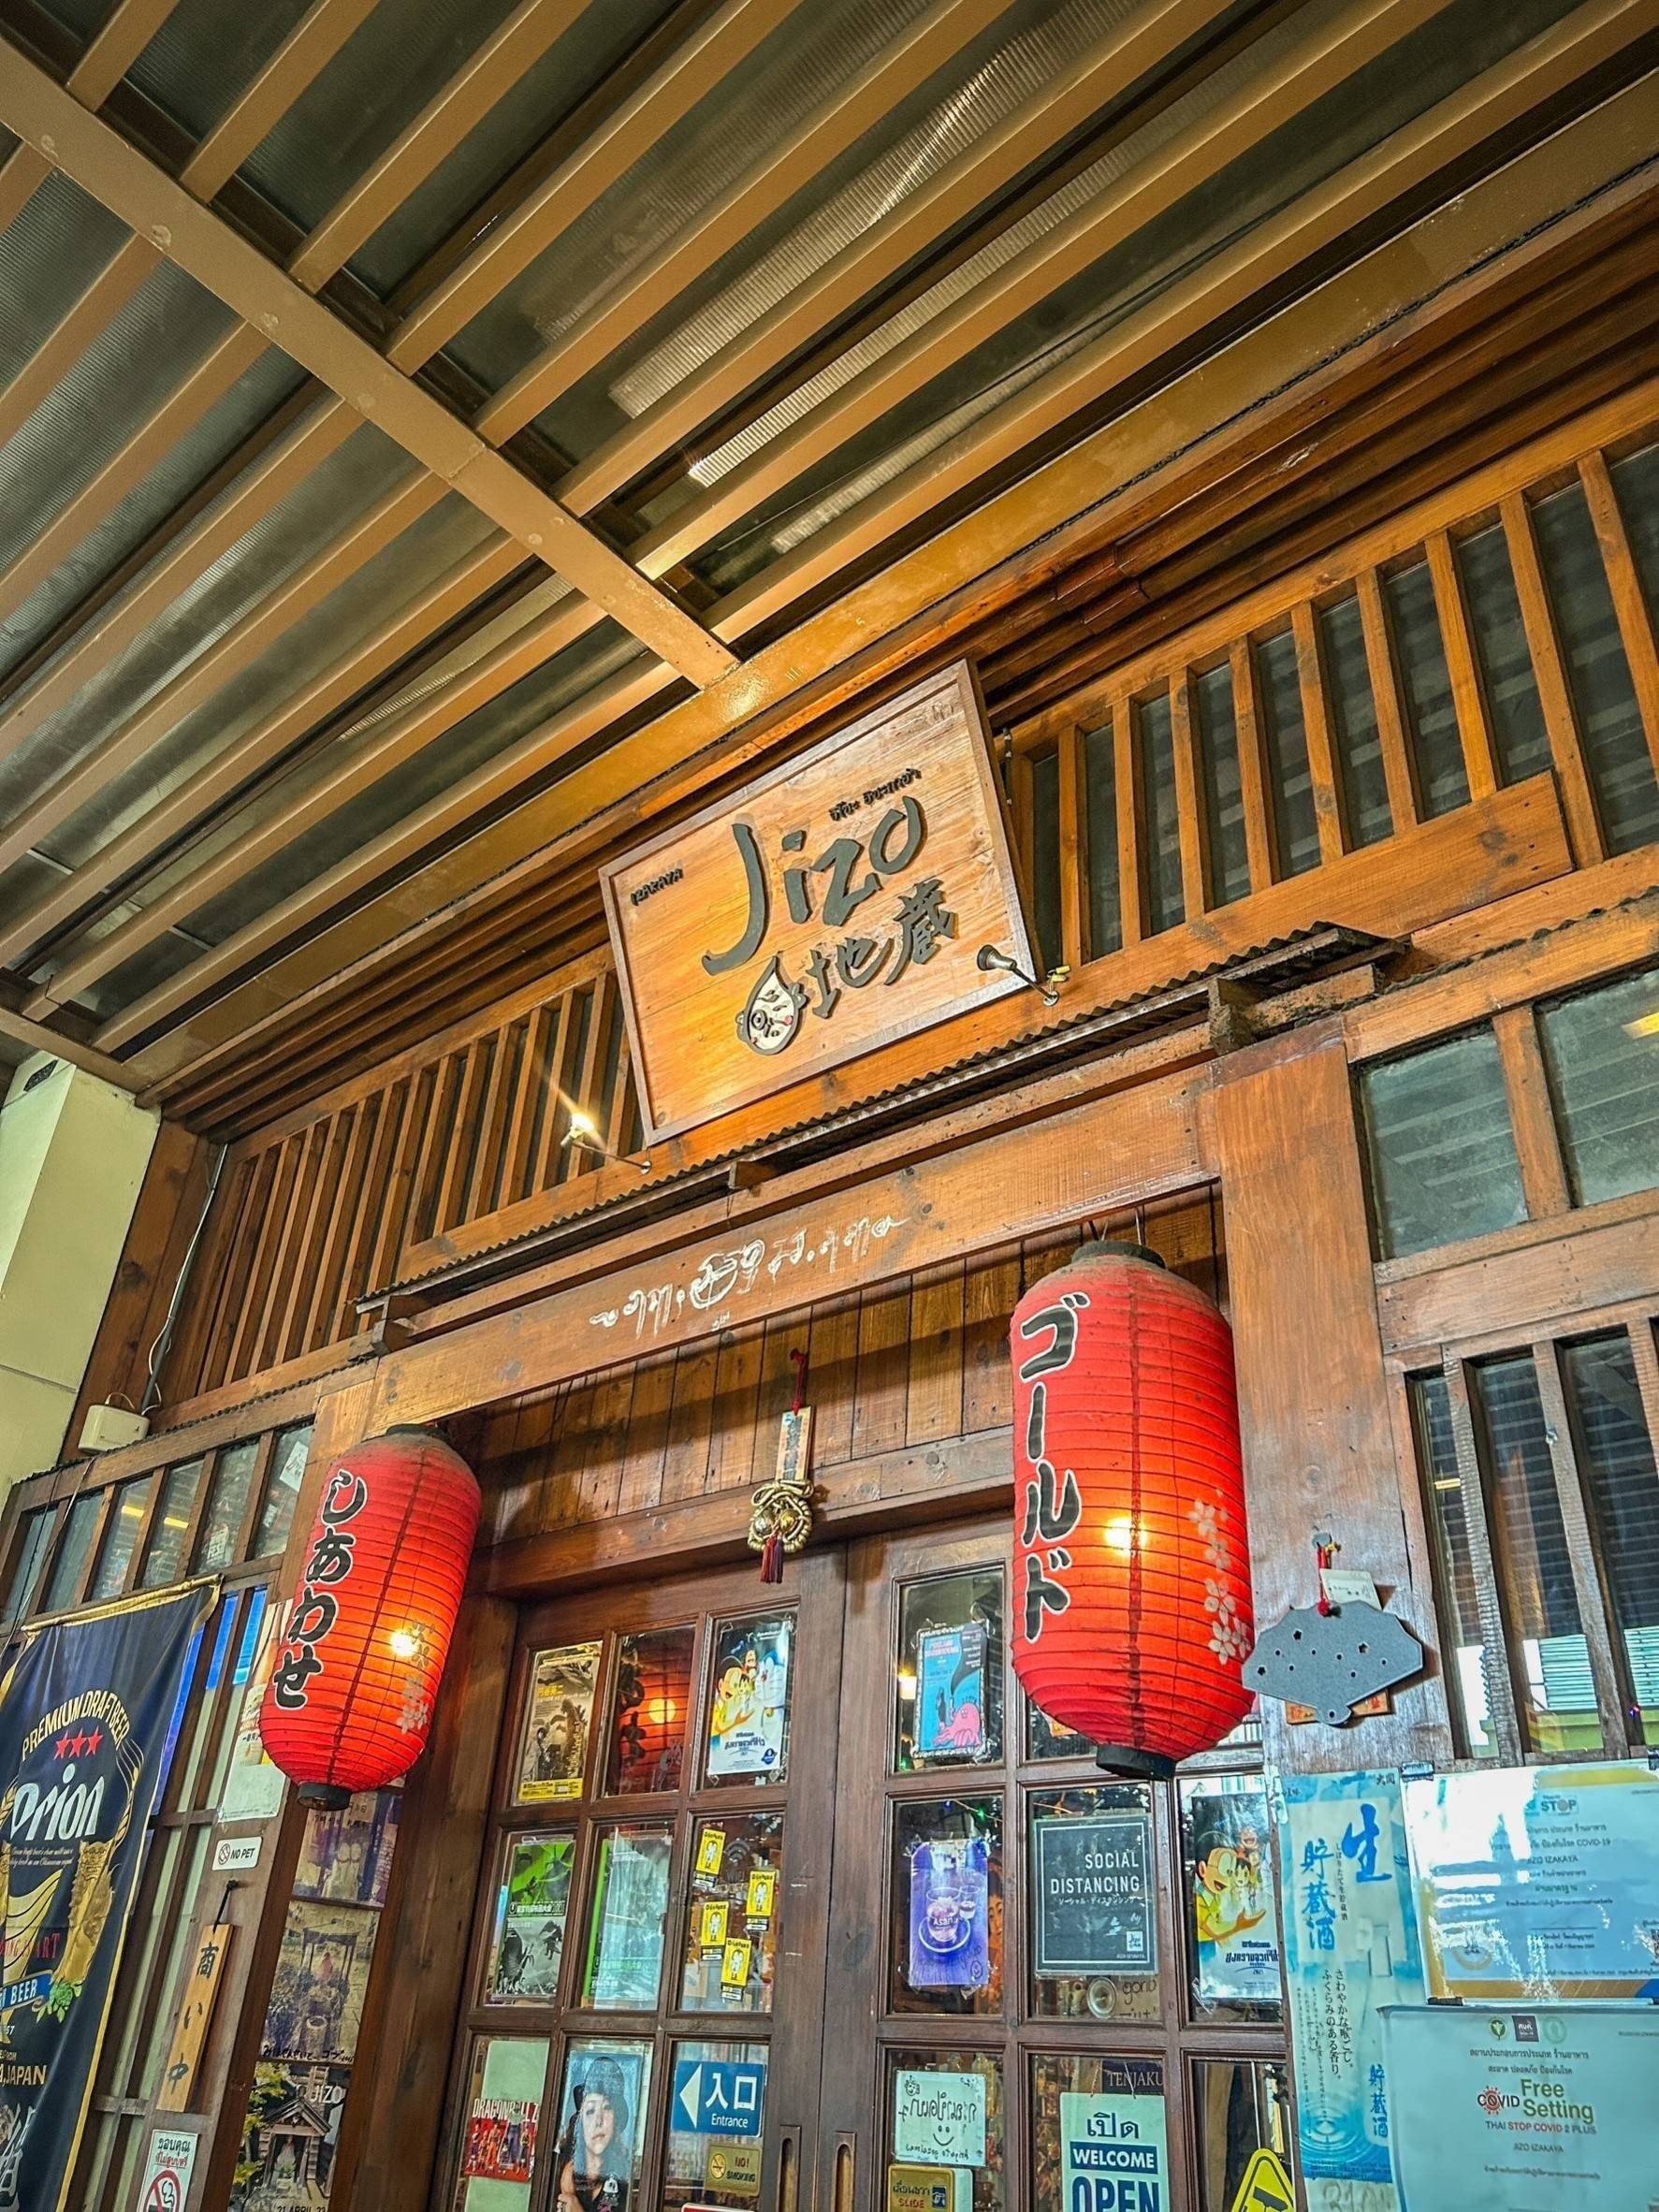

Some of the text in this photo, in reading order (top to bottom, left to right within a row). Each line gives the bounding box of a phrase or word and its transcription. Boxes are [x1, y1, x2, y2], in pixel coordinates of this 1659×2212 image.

[631, 867, 684, 906] IZAKAYA
[702, 796, 926, 976] Jizo
[807, 880, 956, 1019] 地蔵
[1019, 1291, 1093, 1644] ゴールド
[273, 1468, 368, 1710] しあわせ
[22, 1690, 130, 1762] PREMIUM DRAFT BEER
[10, 1763, 105, 1841] Orion
[230, 1848, 255, 1859] NO PET
[1341, 1803, 1392, 1883] 生
[1085, 1850, 1140, 1870] SOCIAL
[1050, 1876, 1140, 1895] DISTANCING
[1300, 1838, 1336, 1951] 貯蔵酒
[10, 1979, 37, 2004] BEER
[167, 1942, 219, 2095] 商い中
[706, 2073, 758, 2111] 入口
[1477, 2093, 1520, 2108] COVID
[1521, 2079, 1564, 2098] Free
[531, 2103, 539, 2123] Z
[711, 2113, 749, 2129] Entrance
[1523, 2099, 1594, 2124] Setting
[1086, 2111, 1139, 2139] เปิด
[1485, 2120, 1506, 2131] THAI
[1507, 2121, 1533, 2132] STOP
[1534, 2123, 1563, 2132] COVID
[1571, 2124, 1596, 2134] PLUS
[158, 2138, 191, 2157] ขอบคุณ
[1073, 2148, 1155, 2169] WELCOME
[1531, 2144, 1564, 2153] IZAKAYA
[735, 2157, 749, 2168] NO!
[726, 2171, 756, 2183] SMOKING
[898, 2197, 925, 2209] SLIDE
[1072, 2176, 1160, 2212] OPEN
